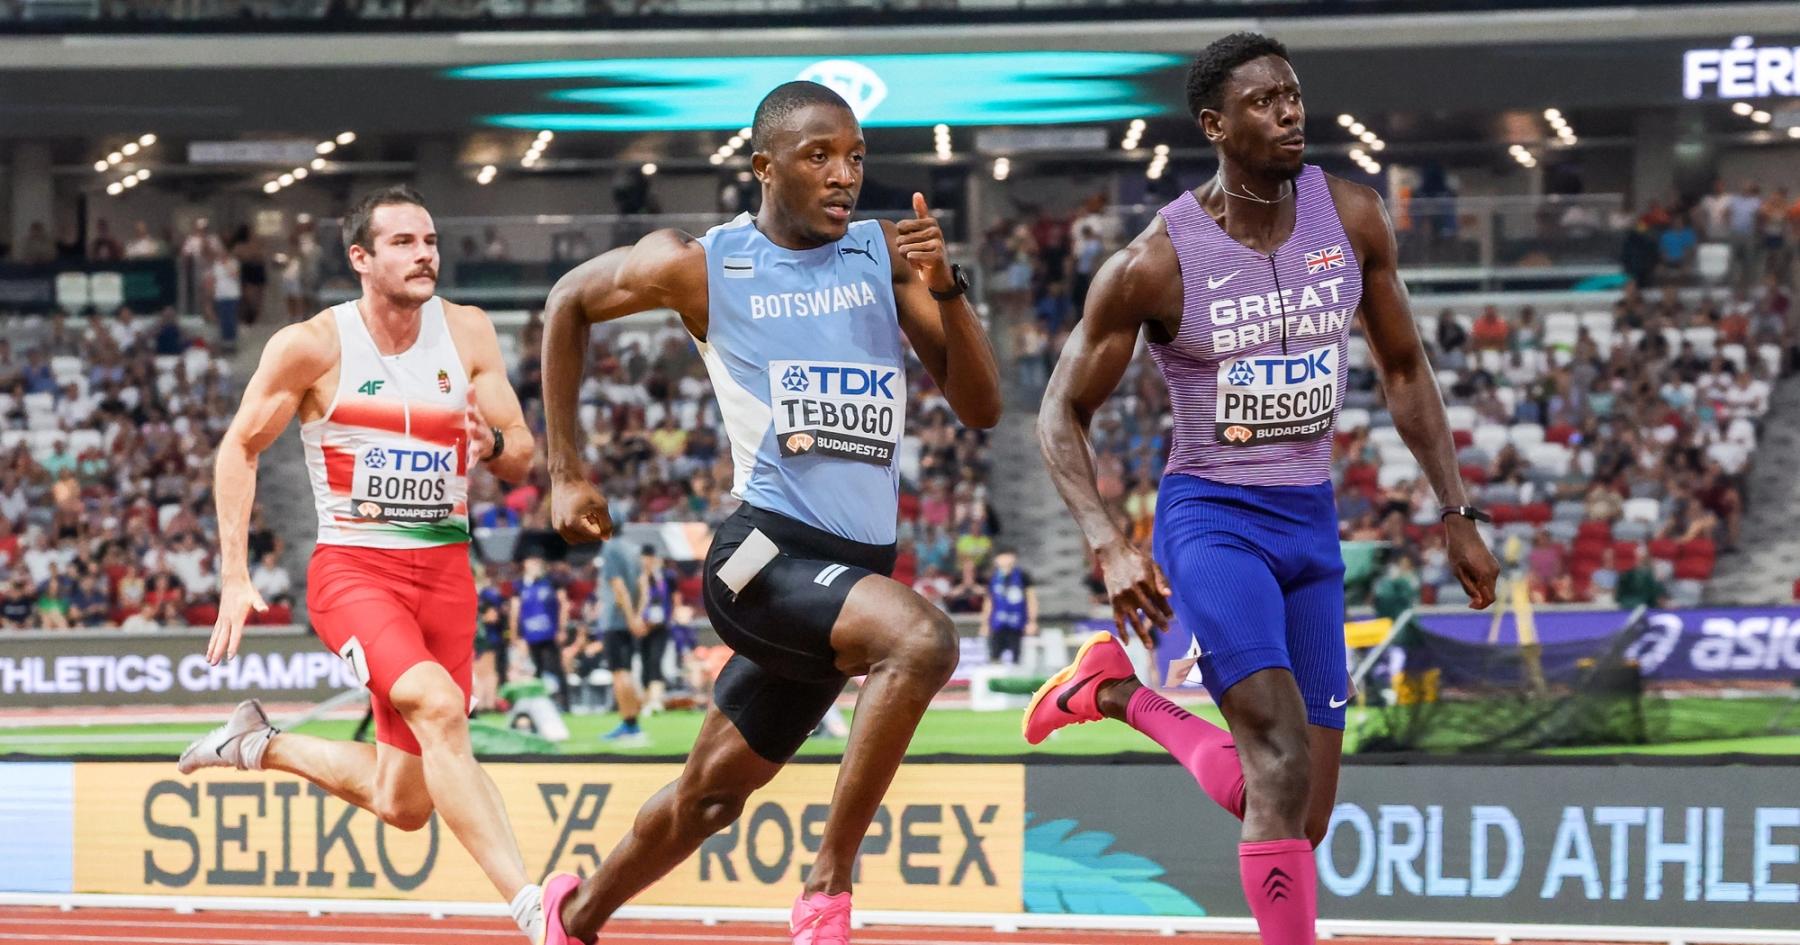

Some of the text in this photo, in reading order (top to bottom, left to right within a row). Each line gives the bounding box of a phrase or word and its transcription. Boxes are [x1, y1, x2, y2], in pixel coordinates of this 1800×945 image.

[750, 281, 876, 319] BOTSWANA
[1210, 277, 1344, 326] GREAT
[1212, 309, 1347, 353] BRITAIN
[809, 366, 896, 400] TDK
[1255, 349, 1332, 385] TDK
[781, 399, 893, 436] TEBOGO
[1224, 384, 1333, 420] PRESCOD
[817, 437, 889, 459] BUDAPEST 23
[1257, 423, 1321, 438] BUDAPEST
[388, 449, 452, 472] TDK
[367, 475, 446, 501] BOROS
[384, 507, 438, 518] BUDAPEST
[143, 780, 1000, 891] SEIKO ROSPEX
[1316, 803, 1800, 903] ORLD ATHLE
